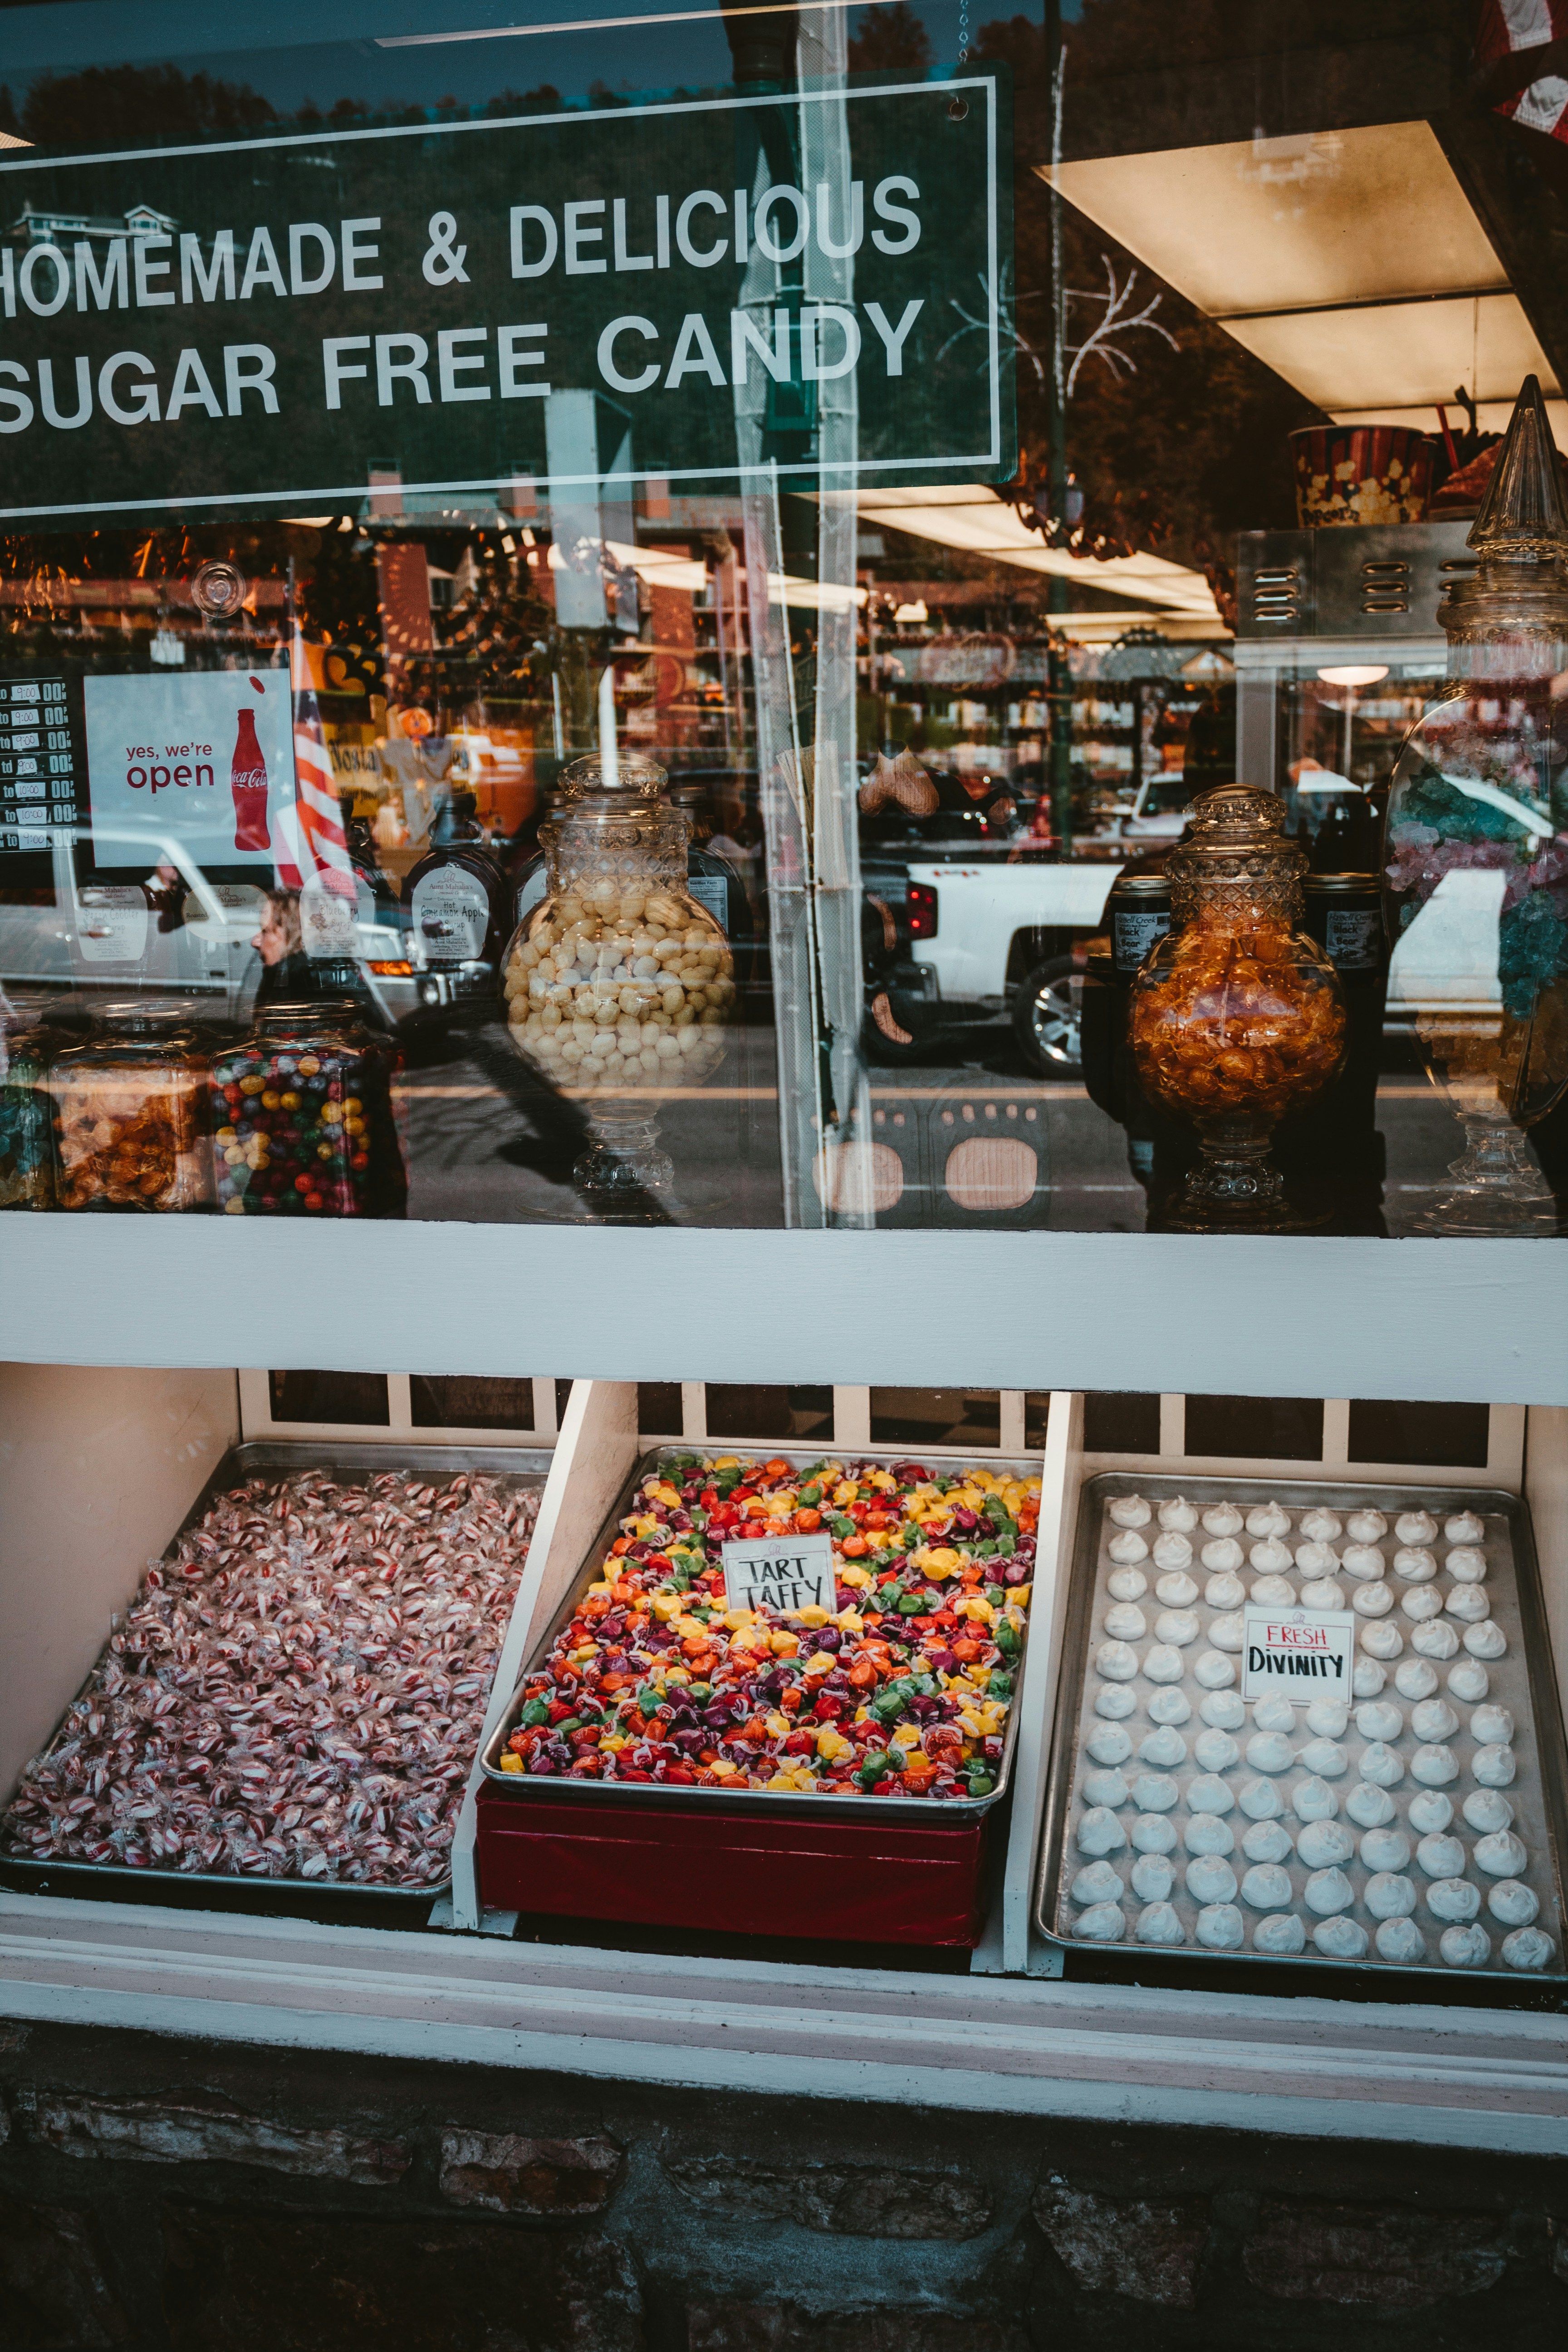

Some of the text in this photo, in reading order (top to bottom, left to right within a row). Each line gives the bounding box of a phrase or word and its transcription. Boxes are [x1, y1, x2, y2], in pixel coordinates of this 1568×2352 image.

[422, 211, 471, 286] &
[510, 175, 922, 279] DELICIOUS
[0, 299, 926, 434] SUGAR FREE CANDY
[17, 687, 35, 699] 9:00
[15, 712, 34, 724] 9:00
[16, 735, 35, 746] 9:00
[126, 742, 212, 761] yes, we're
[18, 760, 34, 772] 9:00
[126, 764, 214, 794] open
[3, 785, 15, 798] to
[20, 785, 39, 795] 10:00
[5, 809, 16, 823] to
[22, 809, 43, 819] 10:00
[6, 834, 18, 847] to
[23, 832, 44, 844] 9:00
[421, 905, 459, 917] Cinnamon
[331, 918, 352, 933] Syrup
[1136, 916, 1156, 924] Creek
[1119, 927, 1140, 936] Black
[1333, 924, 1358, 934] Black
[1122, 938, 1141, 947] Bear
[1336, 936, 1358, 946] Bear
[739, 1558, 807, 1583] TART
[739, 1576, 822, 1611] TAFFY
[1267, 1625, 1326, 1645] FRESH
